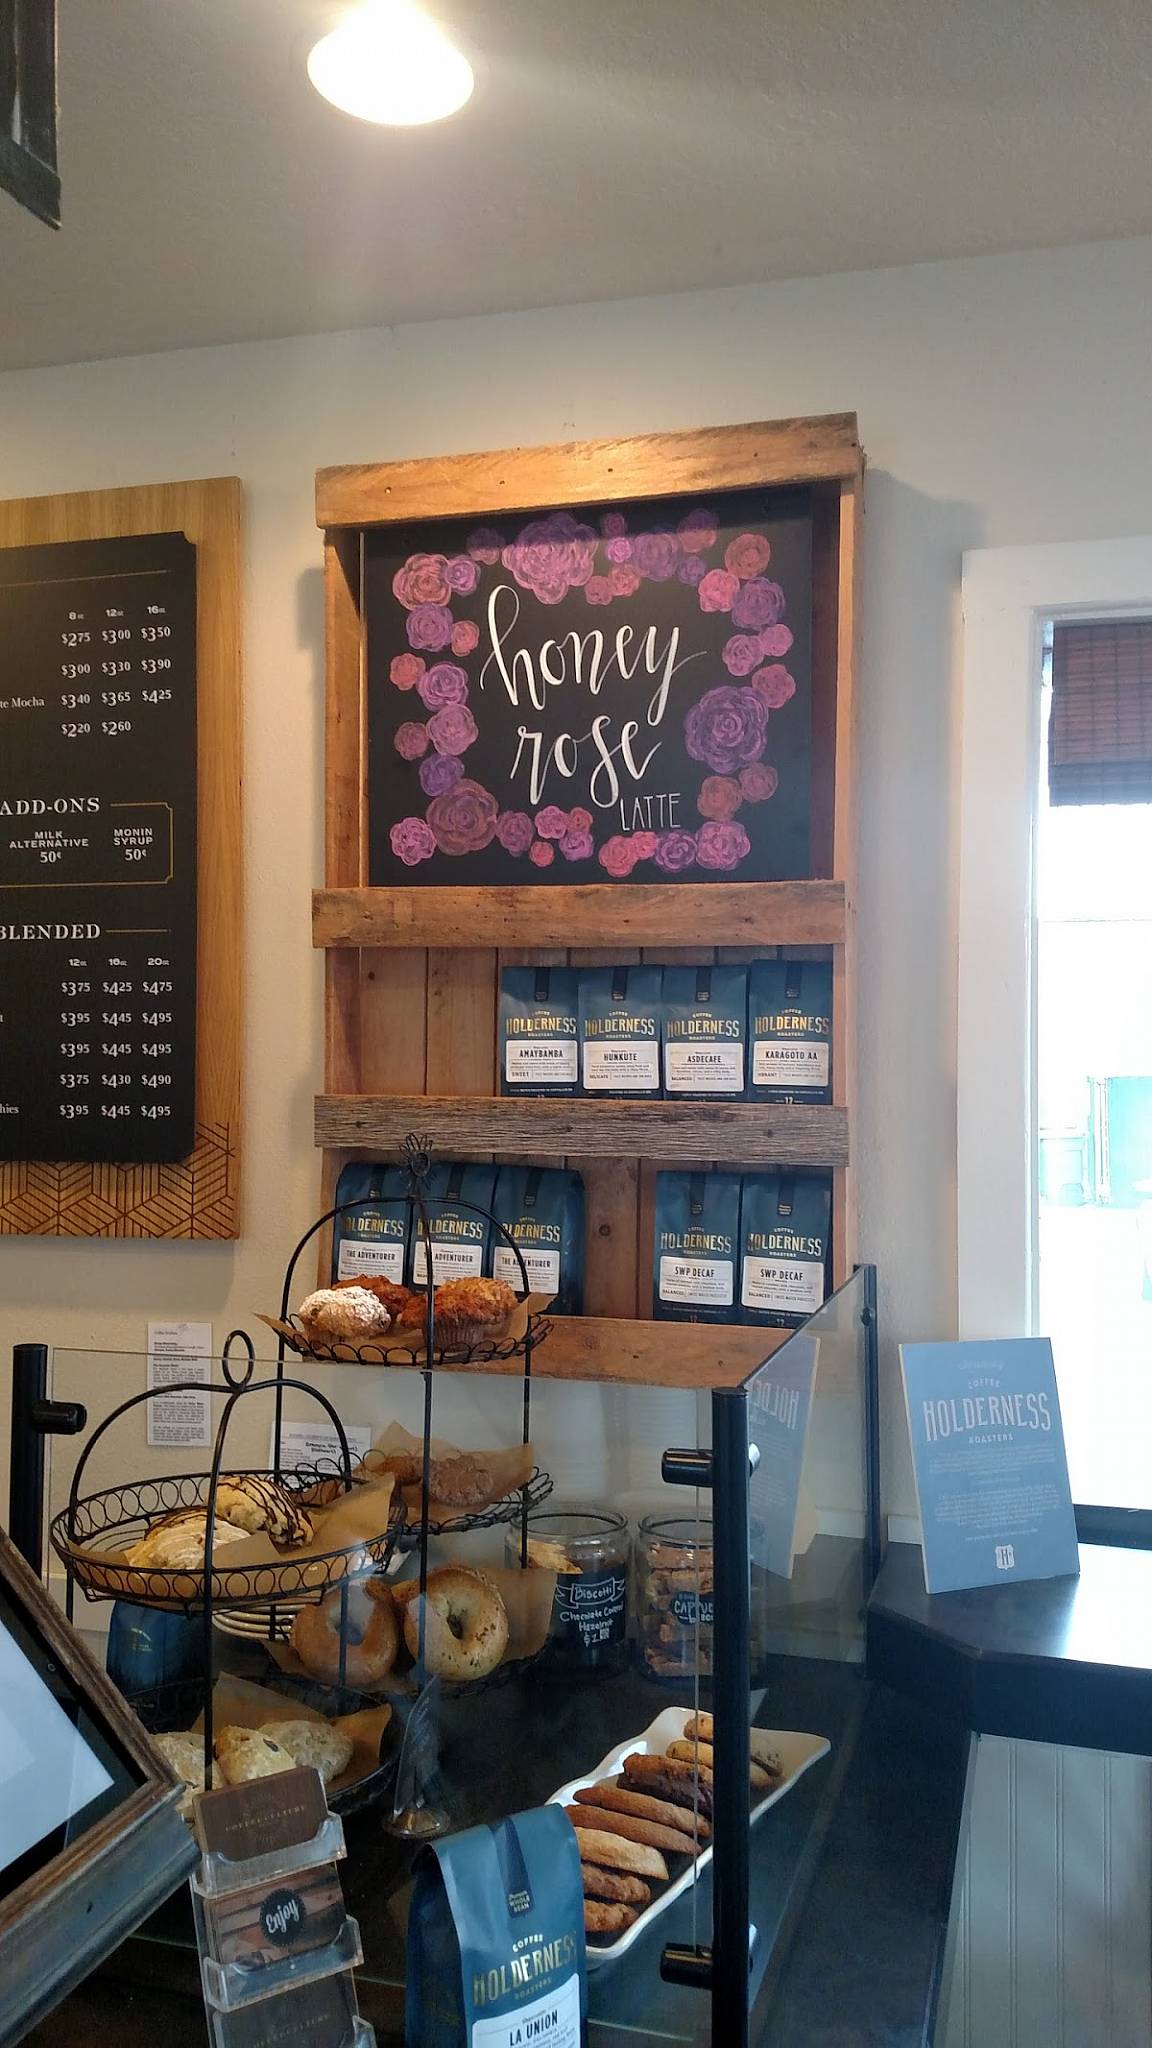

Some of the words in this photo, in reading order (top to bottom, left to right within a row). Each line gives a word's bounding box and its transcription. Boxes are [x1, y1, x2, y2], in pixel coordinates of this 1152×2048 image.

[61, 632, 91, 647] $275
[102, 629, 131, 644] $300
[141, 626, 171, 641] $350
[479, 585, 707, 726] honey
[61, 663, 91, 678] $300
[141, 658, 172, 674] $390
[11, 696, 45, 708] Mocha
[61, 693, 91, 709] $340
[101, 691, 131, 706] $365
[141, 689, 172, 704] $425
[61, 723, 91, 738] $220
[101, 720, 132, 736] $260
[510, 715, 662, 808] rose
[0, 797, 101, 816] ADD-ONS
[619, 793, 681, 831] LATTE
[34, 831, 63, 840] MILK
[113, 827, 153, 837] MONIN
[113, 836, 153, 846] SYRUP
[9, 838, 89, 849] ALTERNATIVE
[0, 923, 101, 940] BLENDED
[61, 982, 91, 996] $375
[102, 981, 133, 996] $425
[142, 981, 173, 996] $475
[60, 1012, 91, 1027] $395
[102, 1012, 132, 1027] $445
[141, 1012, 172, 1027] $495
[506, 1017, 577, 1036] HOLDERNESS
[584, 1018, 655, 1037] HOLDERNESS
[755, 1016, 830, 1034] HOLDERNESS
[667, 1020, 740, 1039] HOLDERNESS
[60, 1043, 90, 1058] $395
[101, 1043, 132, 1058] $445
[141, 1043, 172, 1058] $495
[603, 1052, 638, 1061] HUNKUTE
[765, 1050, 805, 1060] KARAGOTO
[808, 1052, 818, 1060] AA
[60, 1074, 90, 1089] $375
[101, 1074, 132, 1089] $430
[141, 1074, 172, 1089] $490
[59, 1105, 89, 1120] $395
[100, 1105, 131, 1120] $445
[140, 1105, 171, 1120] $495
[417, 1219, 483, 1240] HLDERNESS
[500, 1222, 560, 1243] OLDERNESS
[660, 1232, 732, 1253] HOLDERNESS
[748, 1232, 822, 1257] HOLDERNESS
[357, 1251, 396, 1261] ADVENTURER
[435, 1252, 474, 1262] ADVENTURER
[512, 1258, 551, 1268] AENTURER
[674, 1266, 691, 1276] SWP
[692, 1267, 716, 1278] DECAF
[760, 1268, 777, 1279] SWP
[779, 1270, 804, 1281] DECAF
[923, 1391, 1052, 1442] HOLDERNESS
[575, 1584, 612, 1600] Biscotti
[266, 1899, 299, 1934] Enjoy
[512, 1933, 543, 1952] COFFEE
[510, 2028, 522, 2046] LA
[526, 2009, 558, 2039] UNION
